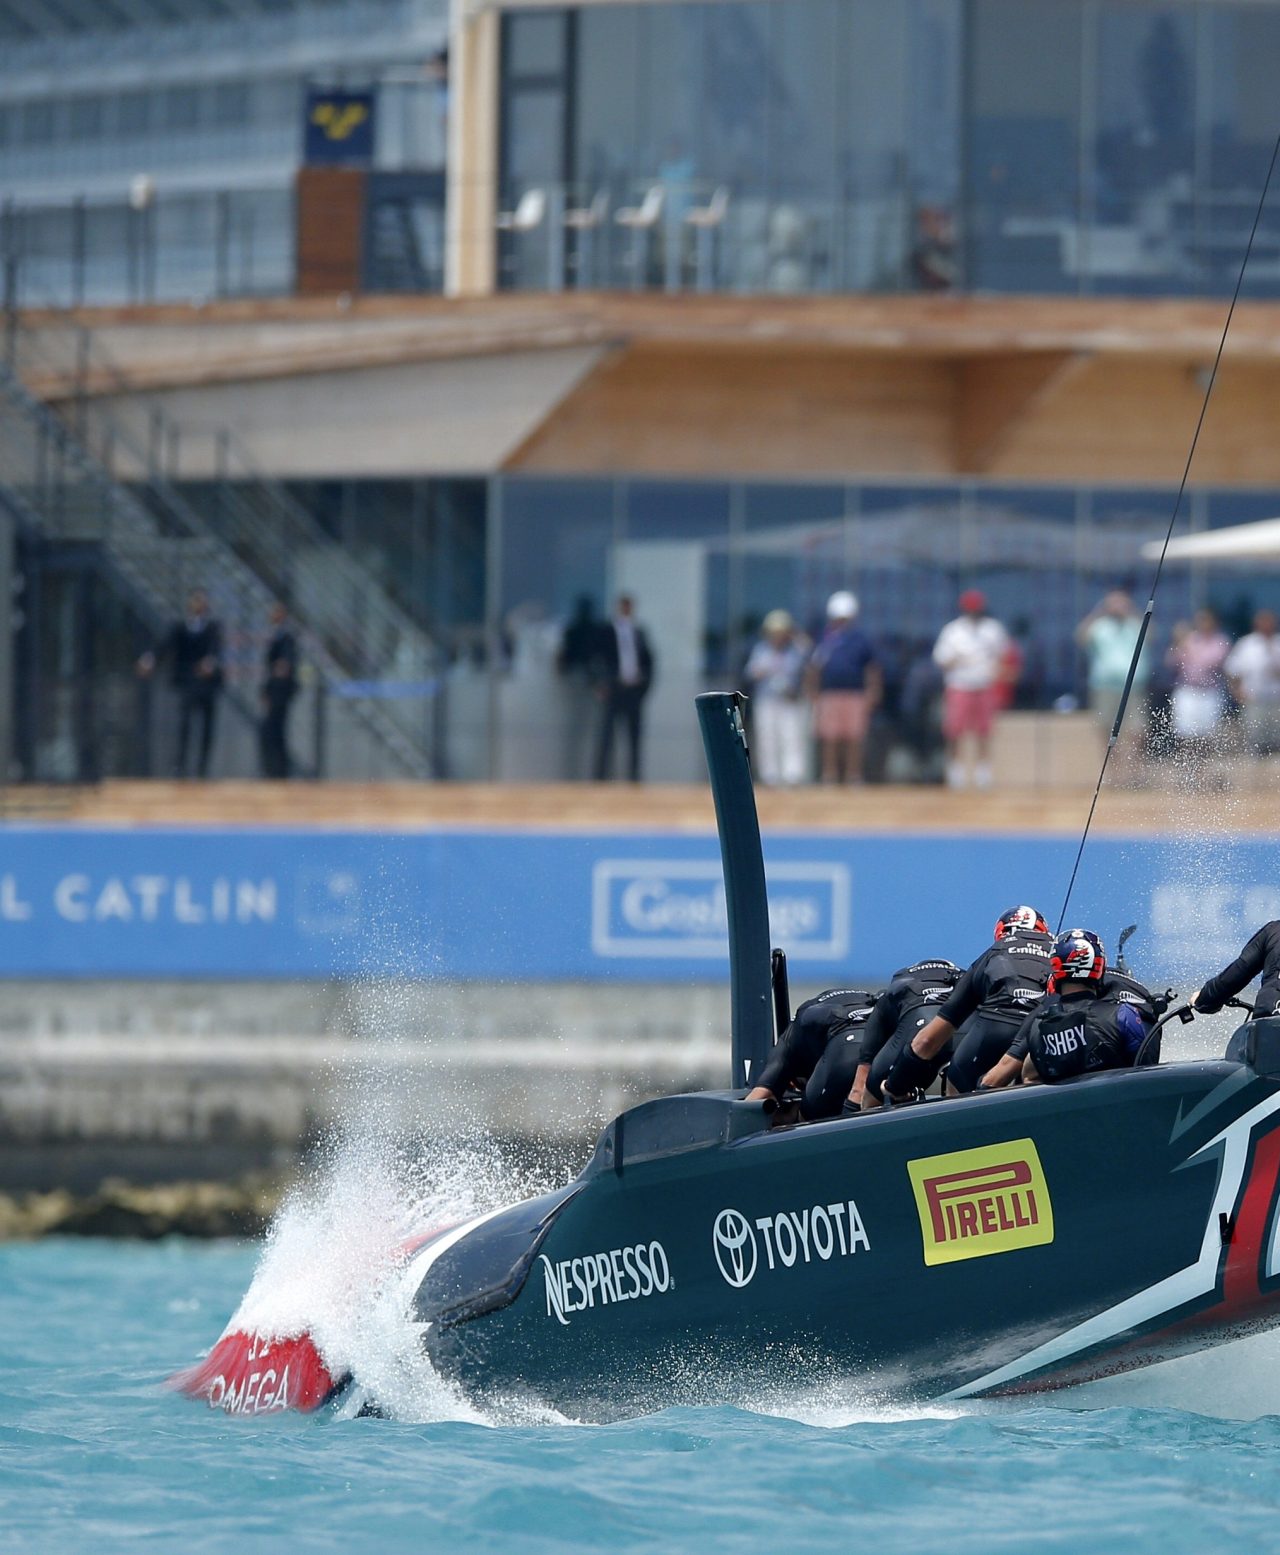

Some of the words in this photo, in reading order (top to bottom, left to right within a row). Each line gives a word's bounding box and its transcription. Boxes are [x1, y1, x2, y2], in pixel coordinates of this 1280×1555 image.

[54, 873, 279, 924] CATLIN
[757, 1200, 871, 1270] TOYOTA
[923, 1161, 1039, 1243] PIRELLI
[539, 1240, 670, 1325] NESPRESSO
[209, 1364, 289, 1413] OMEGA
